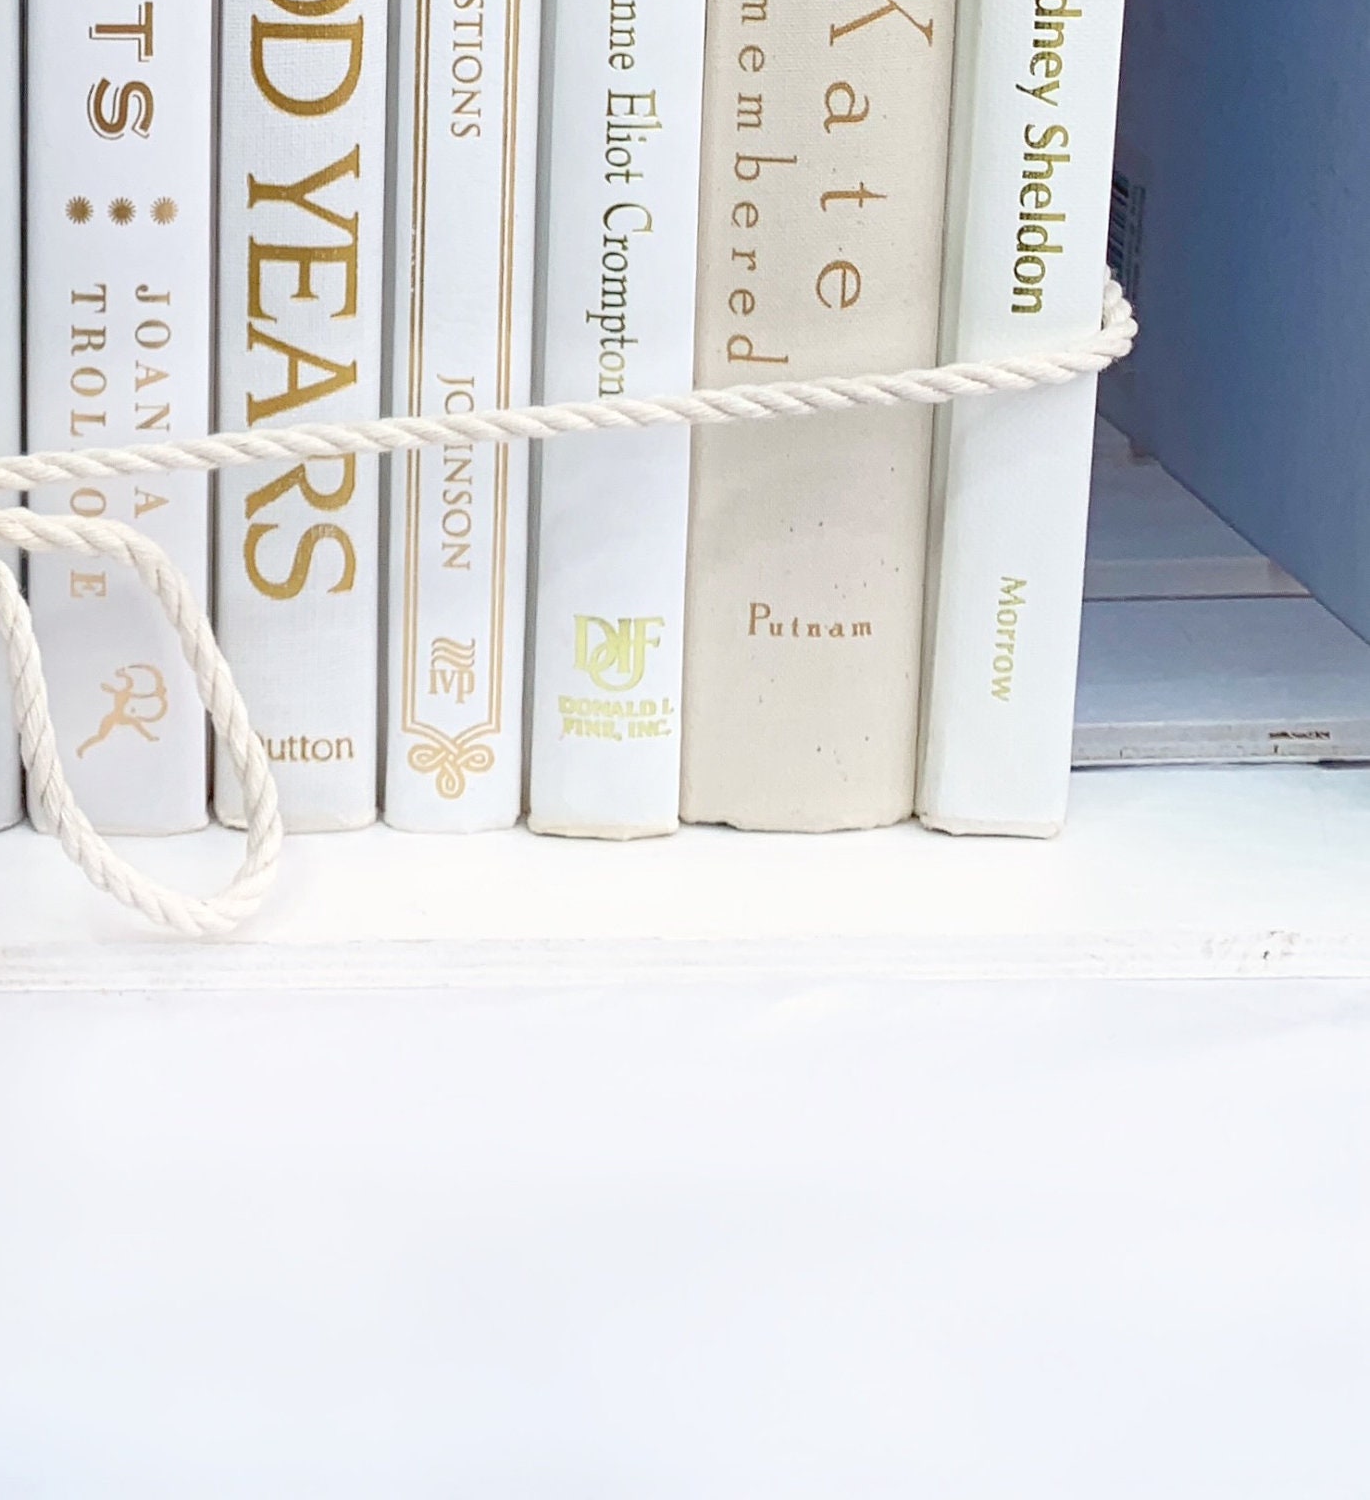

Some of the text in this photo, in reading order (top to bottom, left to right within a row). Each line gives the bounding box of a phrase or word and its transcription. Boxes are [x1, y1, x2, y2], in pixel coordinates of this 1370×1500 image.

[604, 88, 663, 184] Eliot
[1009, 124, 1070, 315] Sheldon
[244, 143, 360, 600] YEARS
[585, 202, 654, 399] Crompton
[69, 283, 107, 598] TROLOE
[135, 284, 171, 518] JOANA
[748, 601, 873, 639] Putnam
[991, 577, 1027, 702] Morrow
[257, 730, 354, 761] utton
[558, 695, 657, 716] DONALD
